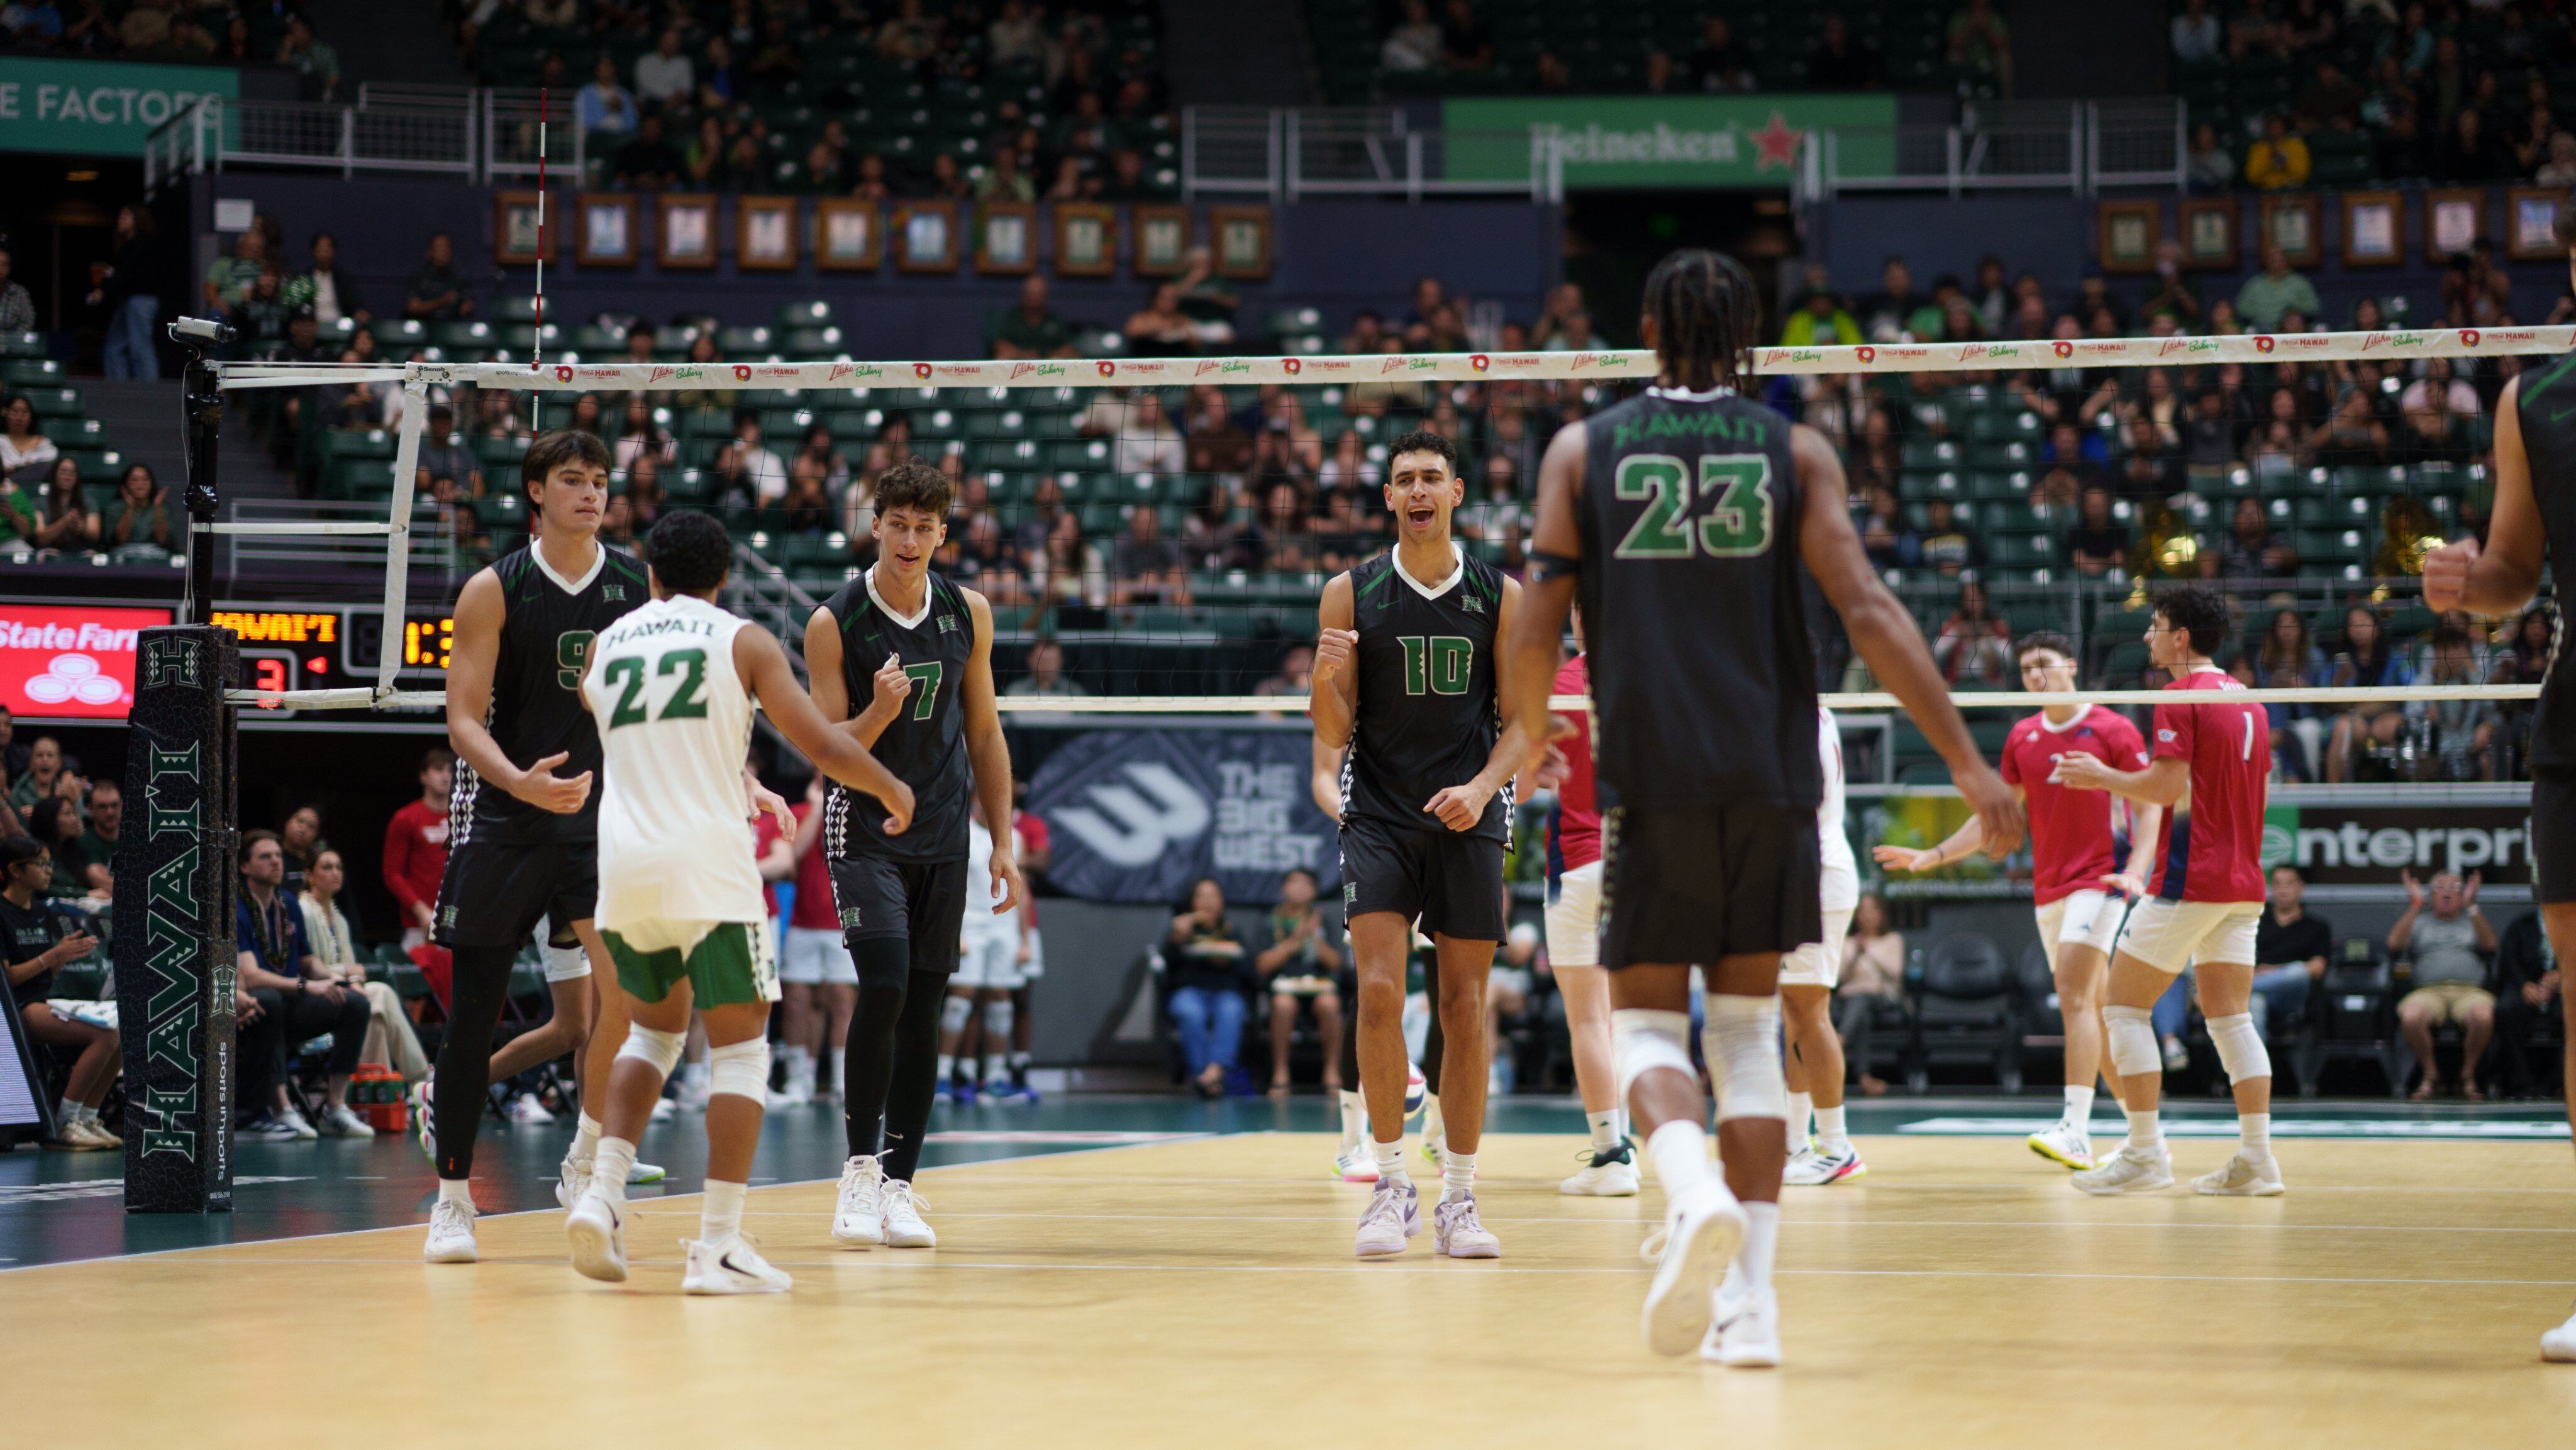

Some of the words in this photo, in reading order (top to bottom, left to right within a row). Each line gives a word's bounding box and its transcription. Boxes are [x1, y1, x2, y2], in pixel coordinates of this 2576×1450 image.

[1792, 350, 1821, 362] Bakery
[1989, 345, 2018, 357] Bakery
[2189, 340, 2219, 352] Bakery
[2392, 335, 2424, 347] Bakery
[675, 368, 702, 379] Bakery
[855, 366, 882, 377] Bakery
[1038, 364, 1065, 376] Bakery
[1222, 361, 1250, 373] Bakery
[1409, 358, 1437, 370] Bakery
[1599, 355, 1628, 367] Bakery
[1613, 452, 1774, 560] 23
[77, 622, 138, 651] Far
[557, 629, 599, 690] 9
[1396, 636, 1474, 695] 10
[257, 659, 285, 709] 3
[605, 647, 708, 731] 22
[902, 660, 943, 721] 7
[2242, 711, 2254, 763] 1
[1216, 762, 1298, 796] THE
[1216, 799, 1292, 833] BIG
[1213, 835, 1323, 870] WEST
[219, 1041, 227, 1104] sports
[217, 1107, 226, 1181] imports
